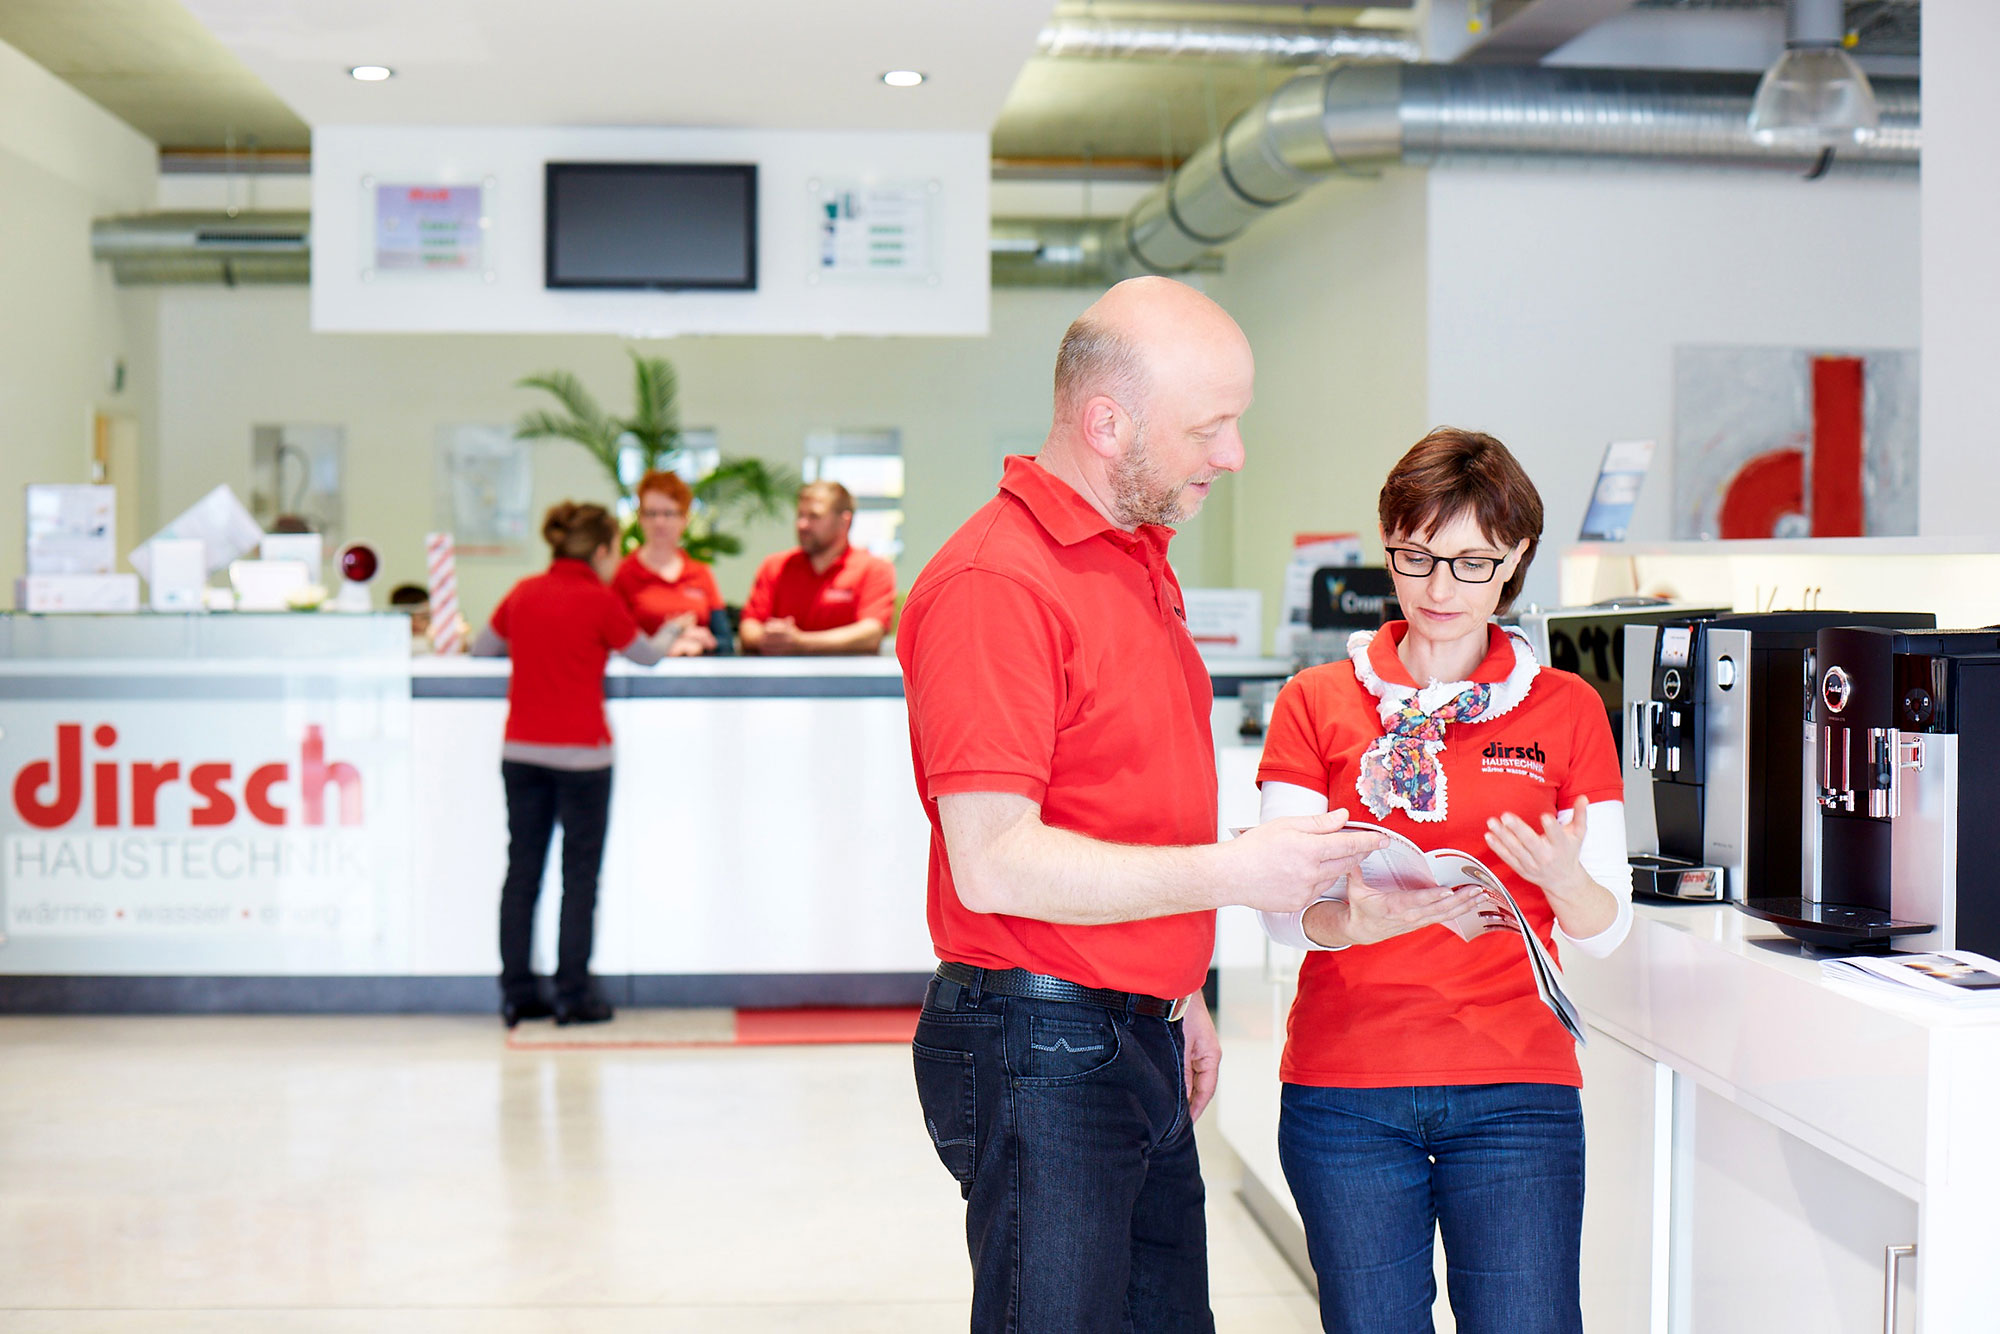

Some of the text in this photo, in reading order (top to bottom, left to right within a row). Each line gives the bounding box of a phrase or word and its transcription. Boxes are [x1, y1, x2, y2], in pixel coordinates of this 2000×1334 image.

[1482, 741, 1545, 764] dirsch
[1482, 758, 1545, 774] HAUSTECHNIK
[12, 722, 364, 829] dirsch
[13, 836, 368, 879] HAUSTECHNIK
